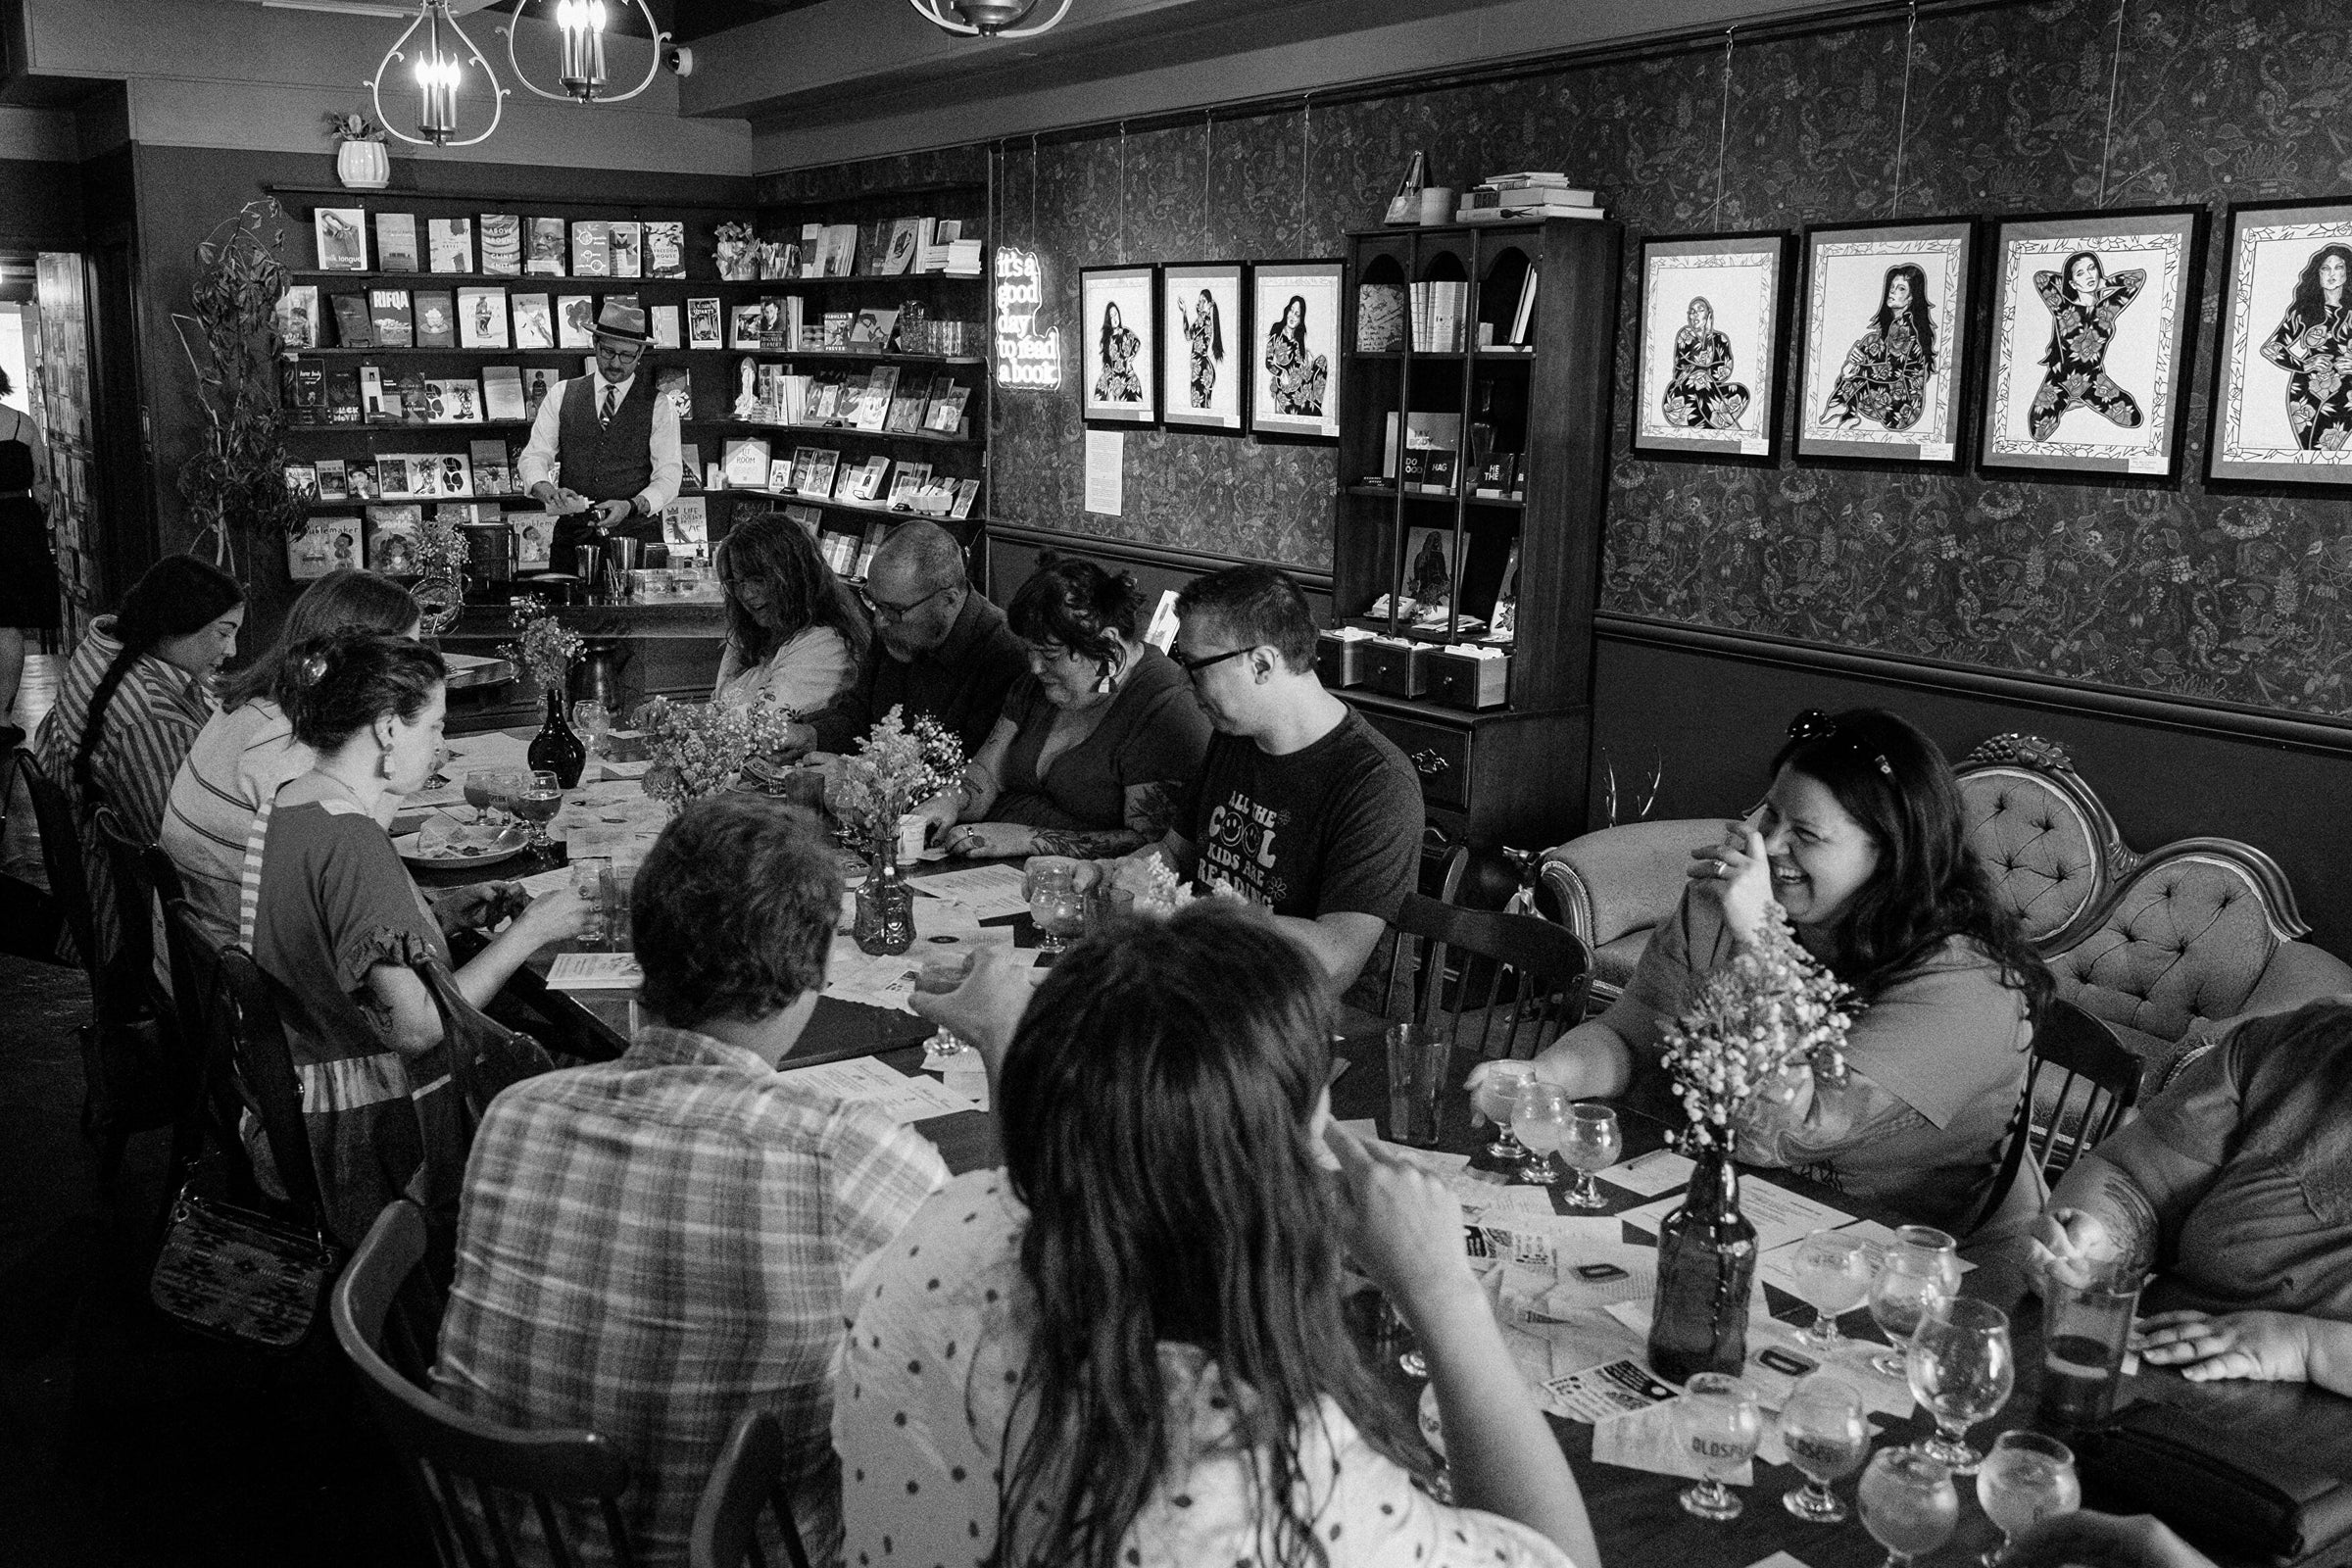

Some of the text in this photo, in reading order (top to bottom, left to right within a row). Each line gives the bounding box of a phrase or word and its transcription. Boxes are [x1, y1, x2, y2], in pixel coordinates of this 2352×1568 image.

[998, 252, 1039, 277] it's a
[373, 291, 409, 310] RIFQA
[998, 275, 1039, 310] good
[998, 308, 1032, 339] day
[998, 331, 1056, 360] to read
[999, 364, 1010, 383] a
[1432, 463, 1447, 472] HAG
[1489, 465, 1500, 473] HE
[307, 525, 359, 535] ublemaker
[510, 518, 557, 528] Troublema
[1228, 790, 1278, 829] ALL THE
[1208, 805, 1277, 869] COOL
[1206, 842, 1265, 888] KIDS ARE
